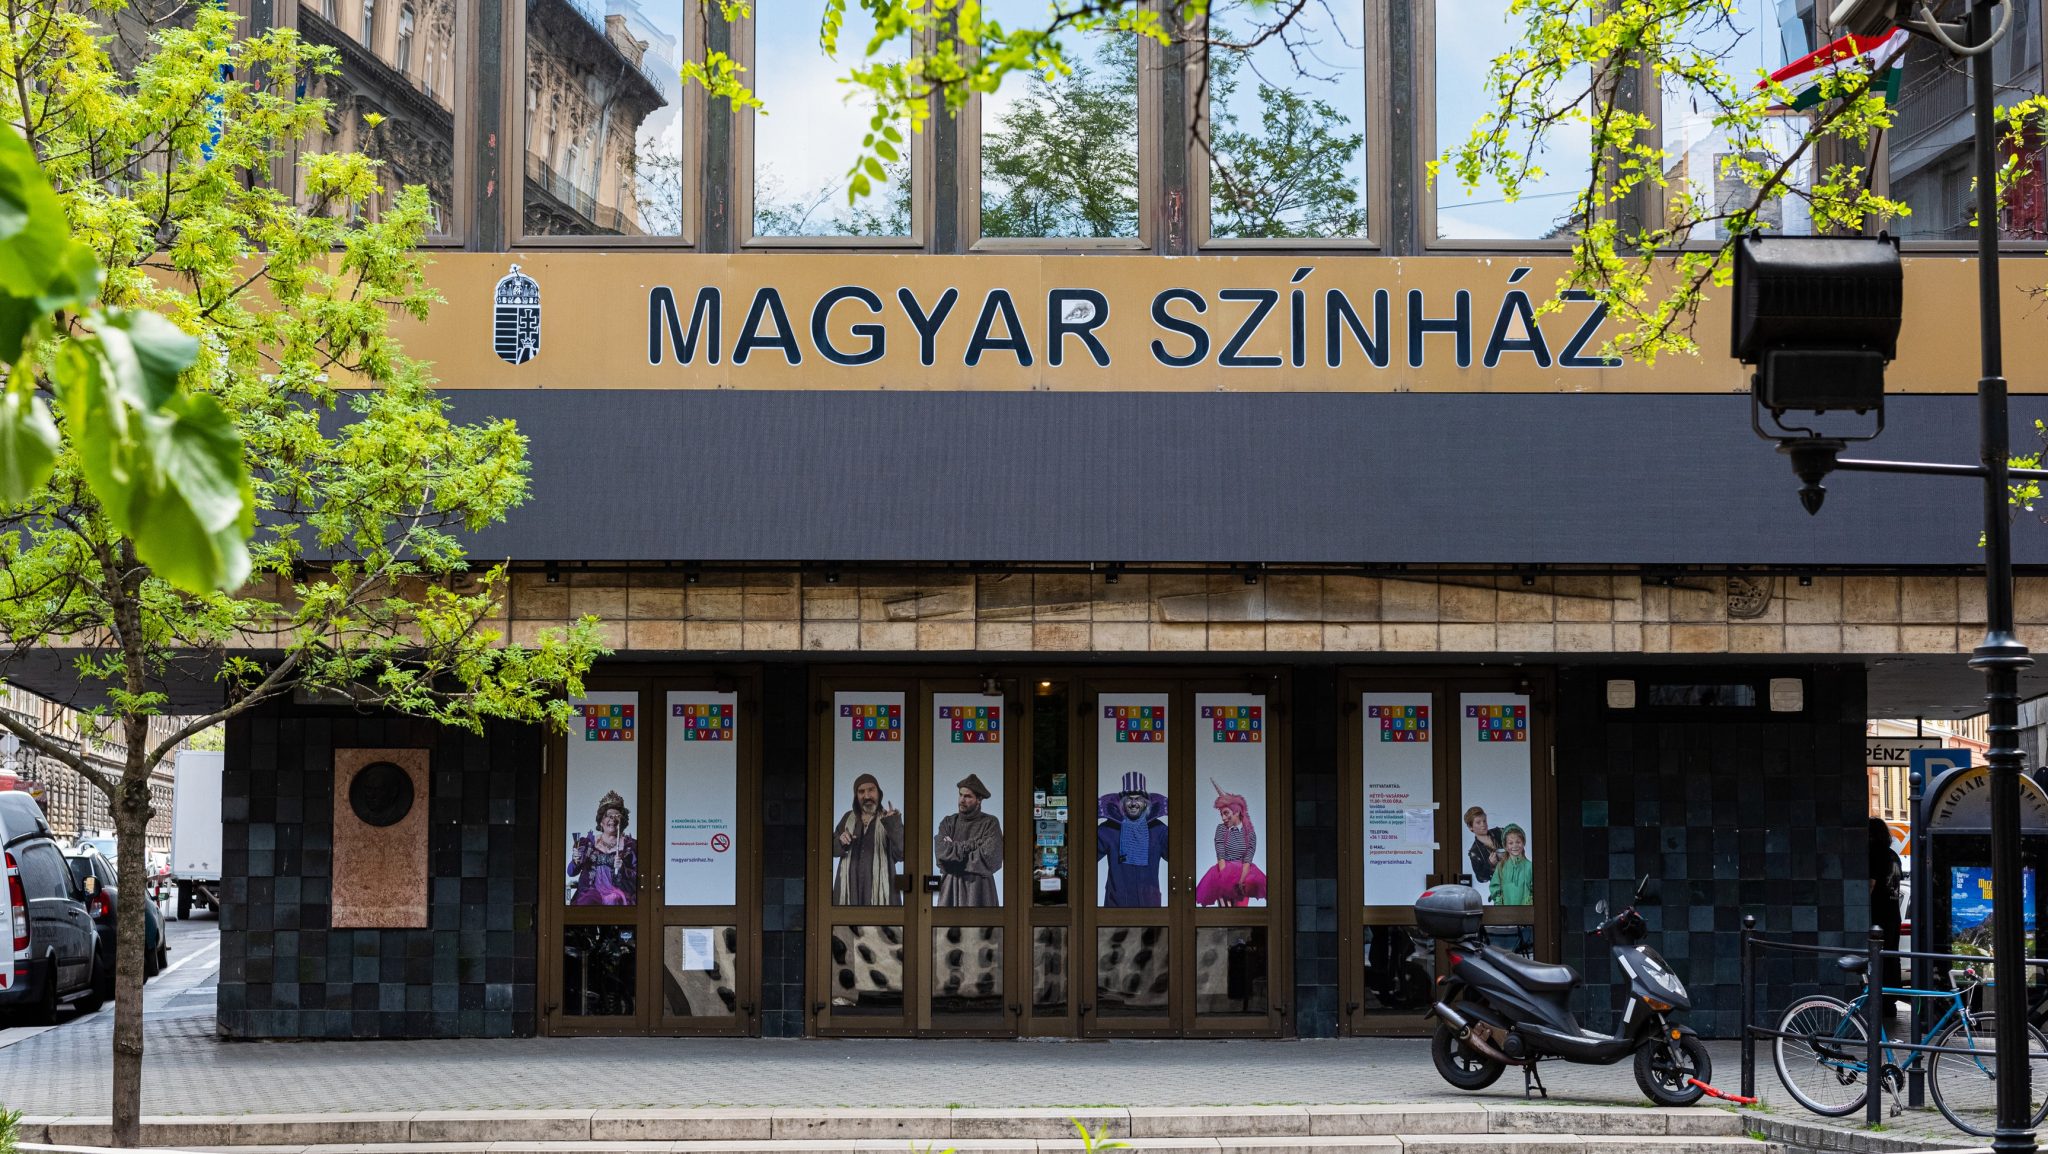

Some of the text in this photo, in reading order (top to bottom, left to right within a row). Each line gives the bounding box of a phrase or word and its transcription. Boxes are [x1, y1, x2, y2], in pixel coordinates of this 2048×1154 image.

[648, 266, 1625, 369] MAGYAR SZÍNHÁZ
[589, 728, 632, 739] ÉVAD
[688, 728, 730, 739] ÉVAD
[855, 728, 898, 740] ÉVAD
[954, 730, 998, 741] ÉVAD
[1119, 730, 1162, 741] ÉVAD
[1216, 730, 1259, 741] ÉVAD
[1383, 729, 1426, 740] ÉVAD
[1481, 729, 1524, 740] ÉVAD
[1866, 744, 1923, 761] PÉNZ
[1940, 775, 1986, 819] MAGYAR
